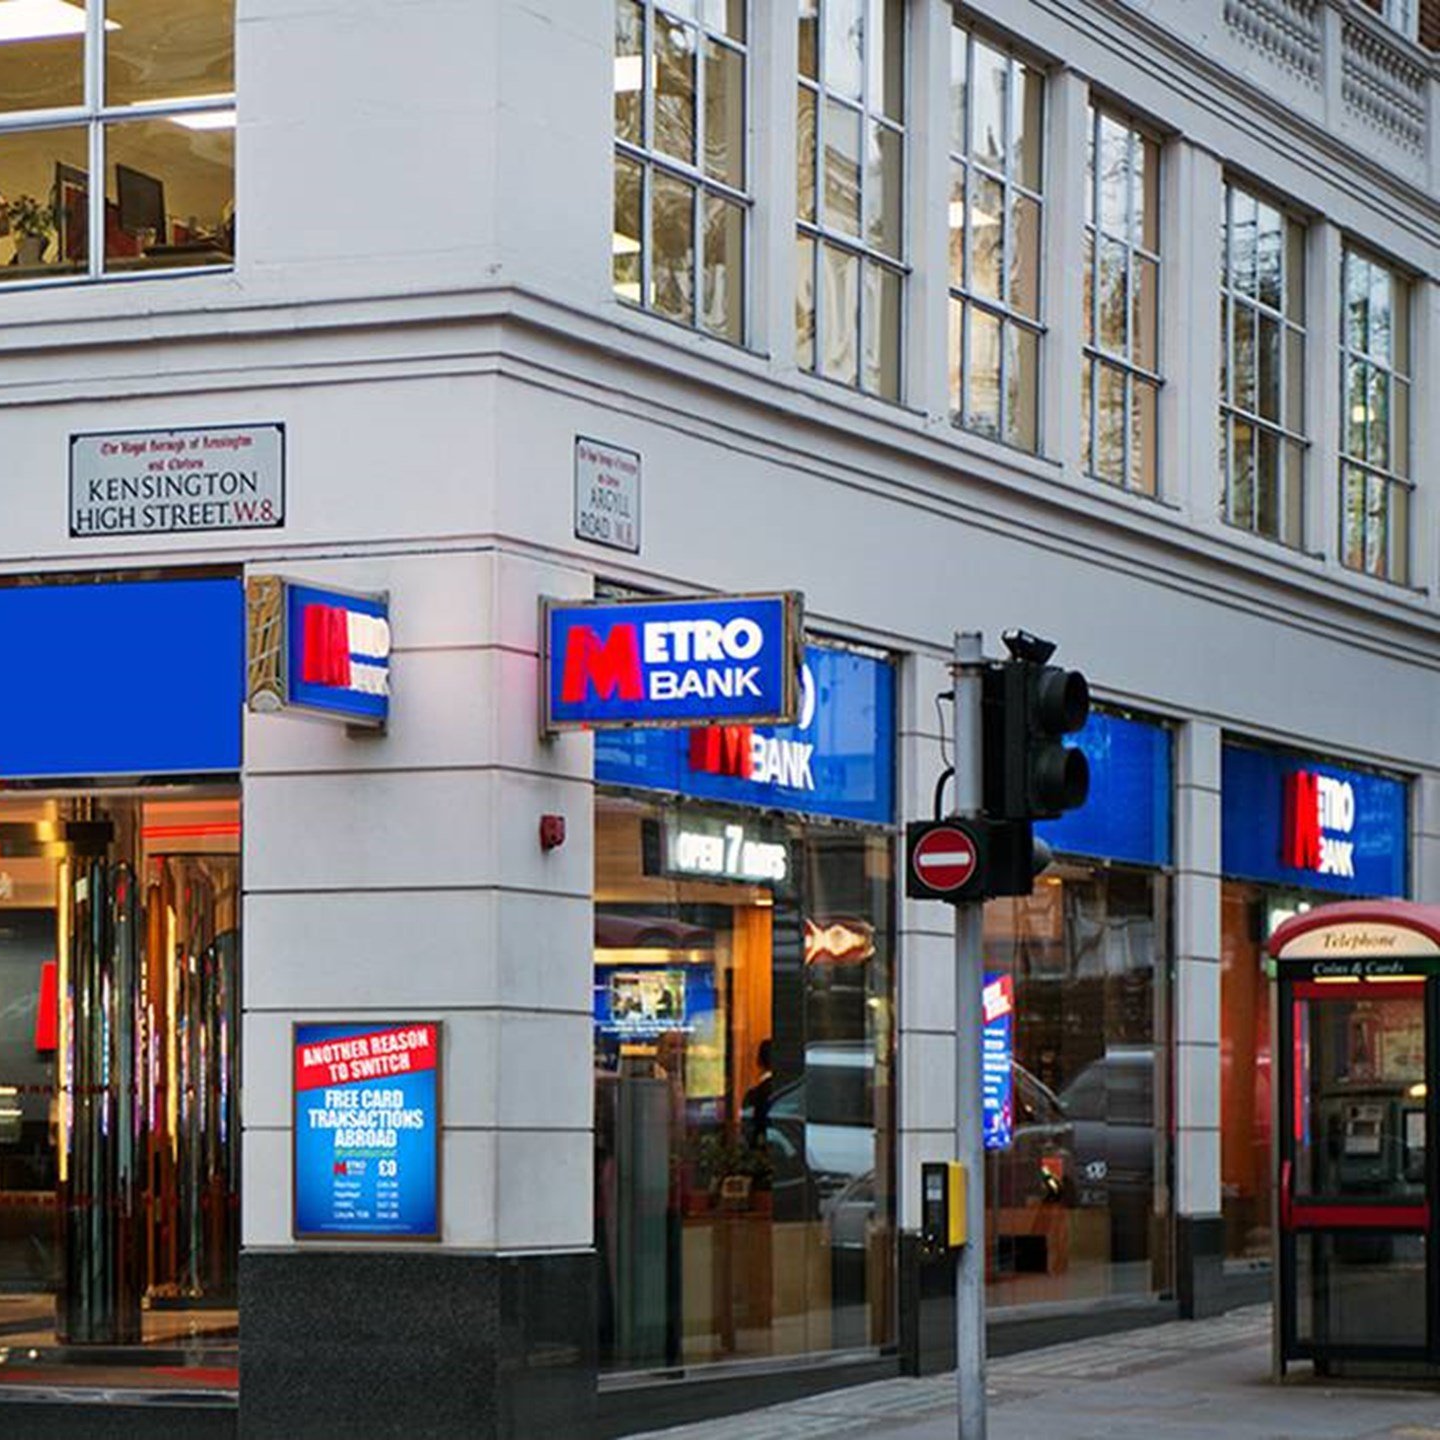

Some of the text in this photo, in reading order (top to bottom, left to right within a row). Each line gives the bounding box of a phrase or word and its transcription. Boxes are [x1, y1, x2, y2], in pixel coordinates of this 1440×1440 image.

[89, 471, 258, 501] KENSINGTON
[76, 506, 136, 531] HIGH
[560, 618, 764, 703] METRO
[649, 667, 763, 701] BANK
[750, 733, 816, 791] BANK
[725, 825, 744, 873] 7
[1323, 932, 1396, 950] Telephone
[1312, 961, 1348, 976] Coins
[1364, 960, 1404, 975] Cards
[303, 1028, 429, 1068] ANOTHER REASON
[328, 1052, 411, 1083] TO SWITCH
[324, 1089, 404, 1110] FREE CARD
[307, 1108, 425, 1129] TRANSACTIONS
[333, 1129, 398, 1149] ABROAD
